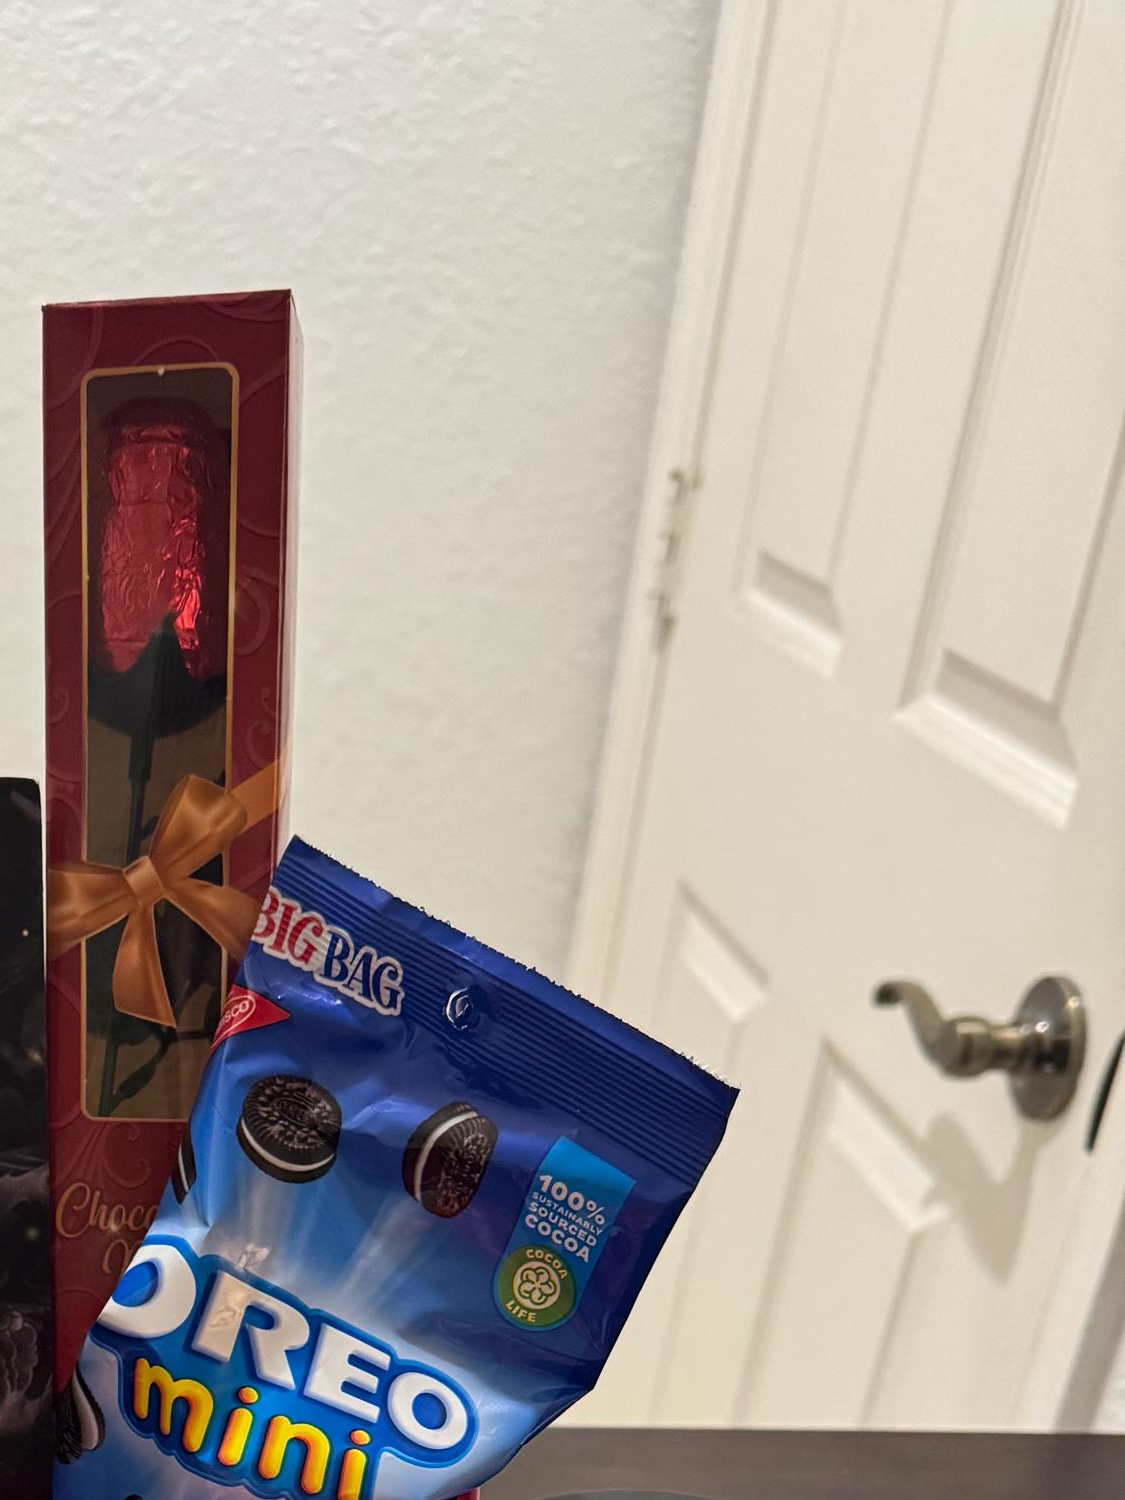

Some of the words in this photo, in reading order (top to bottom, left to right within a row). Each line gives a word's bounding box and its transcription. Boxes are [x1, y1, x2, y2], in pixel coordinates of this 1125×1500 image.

[321, 931, 402, 1011] BAG
[532, 1191, 603, 1236] SUSTAINABLY
[539, 1174, 605, 1225] 100%
[524, 1213, 589, 1263] COCOA
[528, 1201, 597, 1247] SOURCED
[525, 1248, 569, 1280] COCOA
[505, 1299, 537, 1323] LIFE
[95, 1242, 469, 1451] OREO
